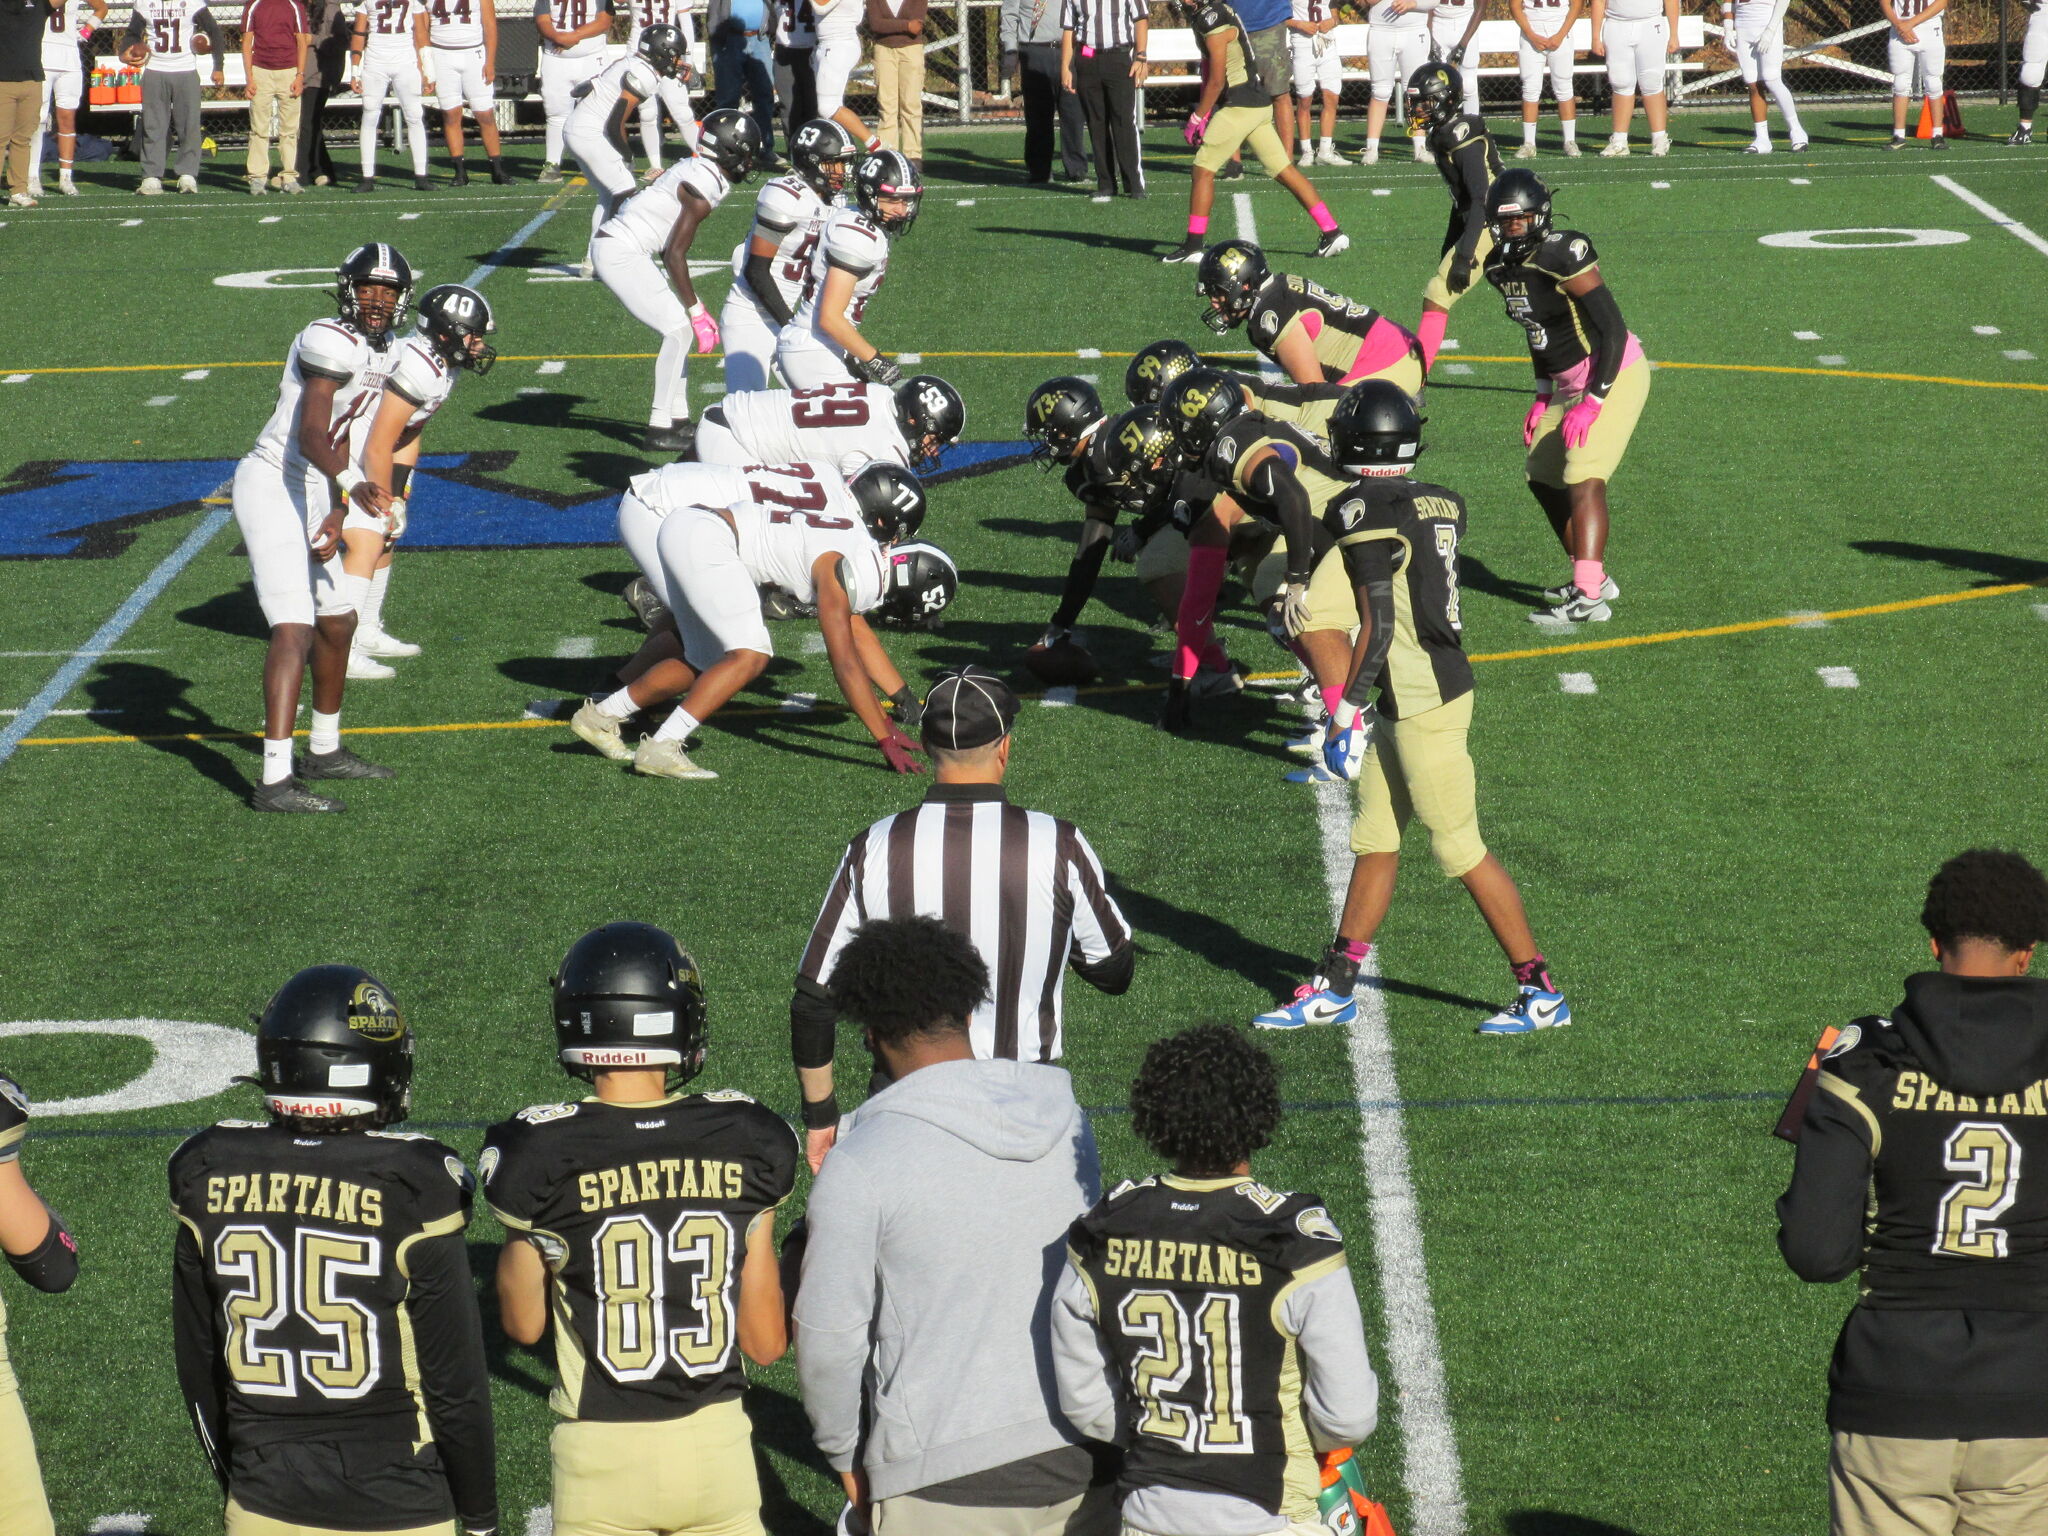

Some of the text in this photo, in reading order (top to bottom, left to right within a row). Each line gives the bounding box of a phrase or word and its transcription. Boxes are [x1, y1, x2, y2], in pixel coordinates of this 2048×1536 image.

[375, 0, 409, 34] 27
[550, 0, 587, 30] 78
[153, 18, 182, 53] 51
[666, 29, 676, 42] 3
[1436, 69, 1449, 86] 9
[734, 117, 747, 133] 4
[797, 126, 821, 146] 53
[860, 156, 883, 178] 26
[1500, 281, 1529, 296] WCA
[443, 293, 475, 318] 40
[1137, 355, 1162, 380] 99
[791, 382, 870, 429] 59
[919, 386, 948, 413] 59
[1032, 392, 1056, 423] 73
[1180, 388, 1208, 418] 63
[1118, 420, 1145, 453] 57
[1360, 466, 1407, 477] Riddell
[891, 482, 920, 512] 77
[1434, 524, 1462, 631] 7
[921, 584, 946, 613] 52
[582, 1052, 647, 1064] Riddell
[272, 1099, 342, 1117] Riddell
[634, 1119, 666, 1130] Riddell
[292, 1138, 322, 1147] Riddell
[206, 1172, 384, 1228] SPARTANS
[577, 1159, 744, 1214] SPARTANS
[1932, 1121, 2022, 1258] 2
[1170, 1201, 1200, 1212] Riddell
[1104, 1237, 1263, 1287] SPARTANS
[591, 1210, 736, 1384] 83
[213, 1224, 381, 1400] 25
[1117, 1288, 1255, 1455] 21
